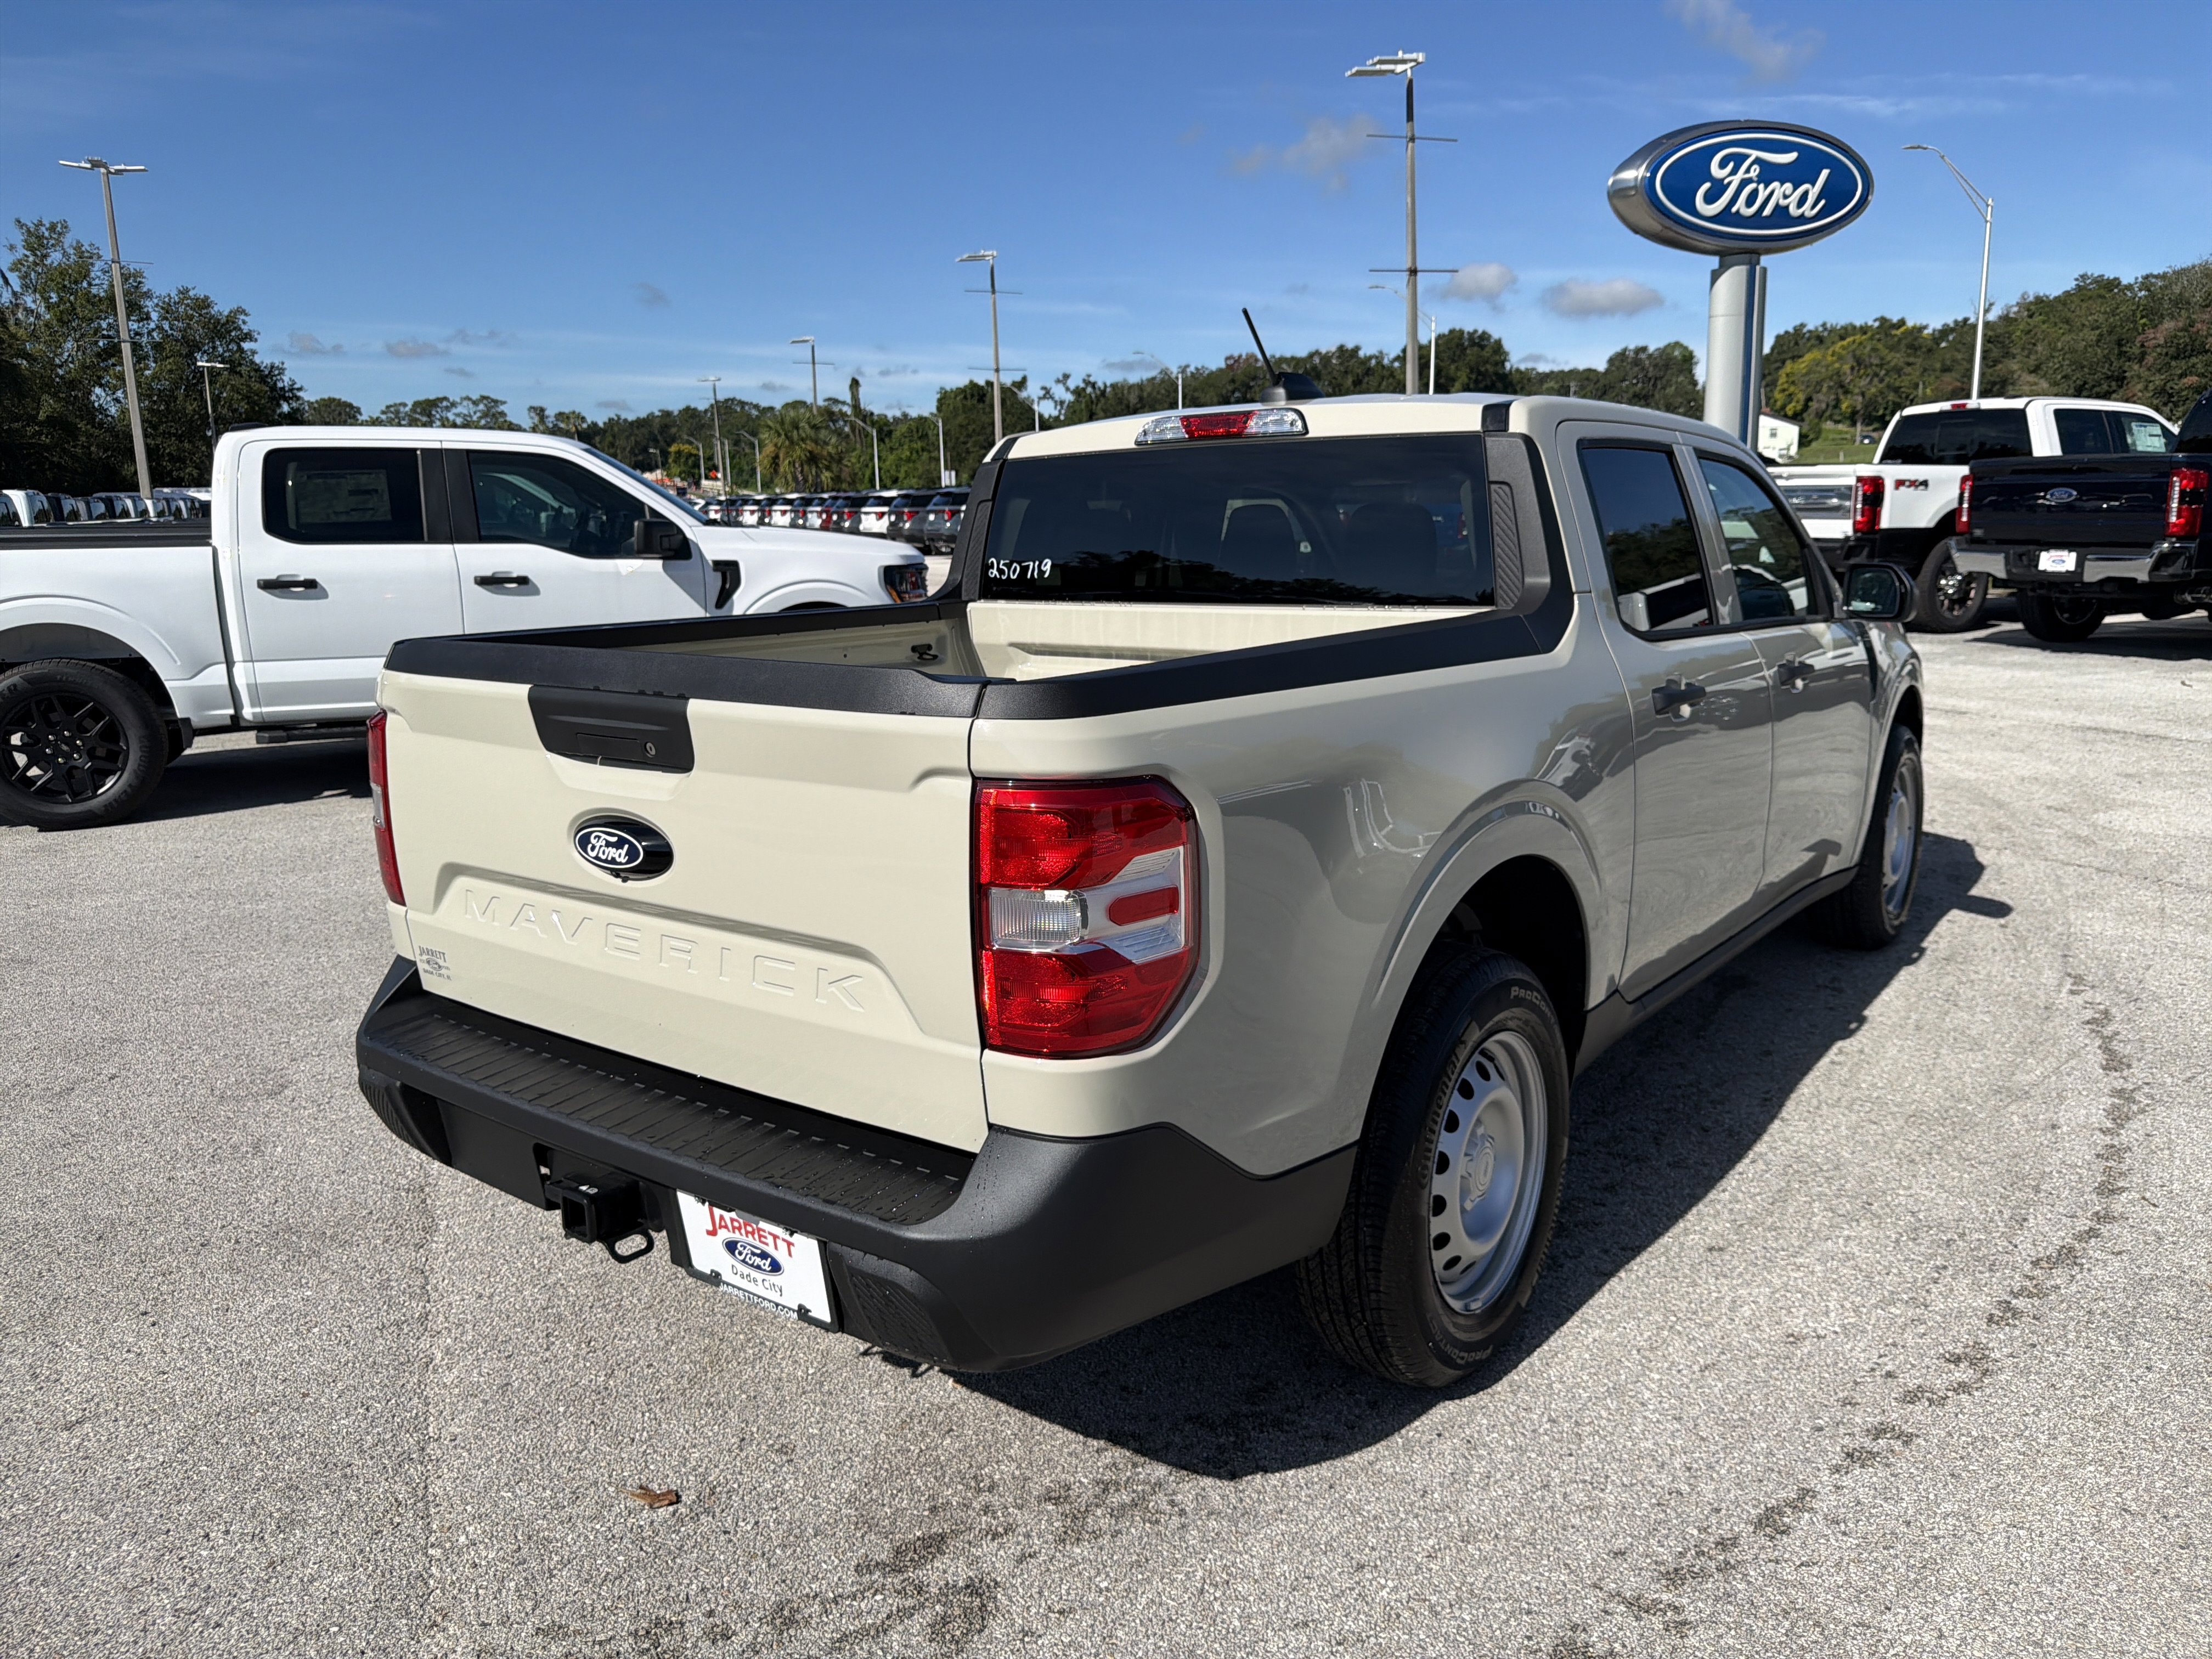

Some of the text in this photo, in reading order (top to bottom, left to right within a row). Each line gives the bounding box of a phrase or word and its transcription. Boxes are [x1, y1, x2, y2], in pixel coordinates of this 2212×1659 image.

[1695, 147, 1831, 218] Ford
[1894, 478, 1929, 489] FX4
[988, 557, 1052, 579] 250719
[587, 832, 629, 863] Ford
[419, 945, 447, 963] JARRETT
[465, 889, 865, 1012] MAVERICK
[706, 1204, 795, 1259] JARRETT
[735, 1242, 772, 1271] Ford
[731, 1264, 783, 1297] Dade City
[719, 1282, 799, 1320] JARRETTFORD.COM
